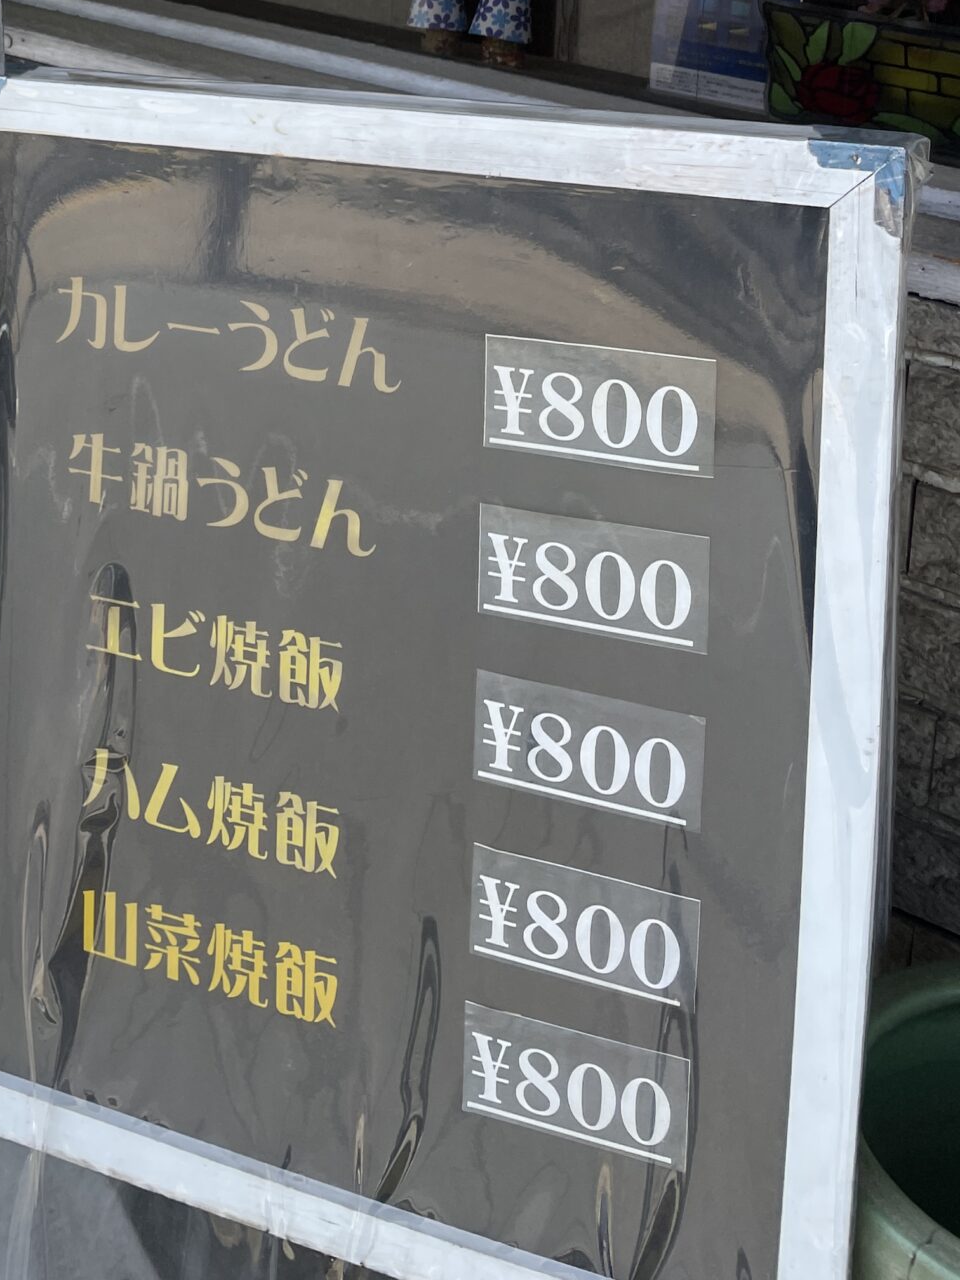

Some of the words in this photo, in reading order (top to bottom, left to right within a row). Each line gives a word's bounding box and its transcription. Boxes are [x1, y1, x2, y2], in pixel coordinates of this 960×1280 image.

[55, 276, 403, 394] カレーうどん
[493, 365, 699, 457] ¥800
[67, 432, 377, 558] 牛鍋うどん
[486, 531, 693, 631] ¥800
[85, 594, 343, 713] エビ焼飯
[481, 698, 687, 809] ¥800
[83, 747, 340, 880] ハム焼飯
[82, 889, 340, 1028] 山菜焼飯
[478, 873, 682, 990] ¥800
[471, 1031, 672, 1147] ¥800
